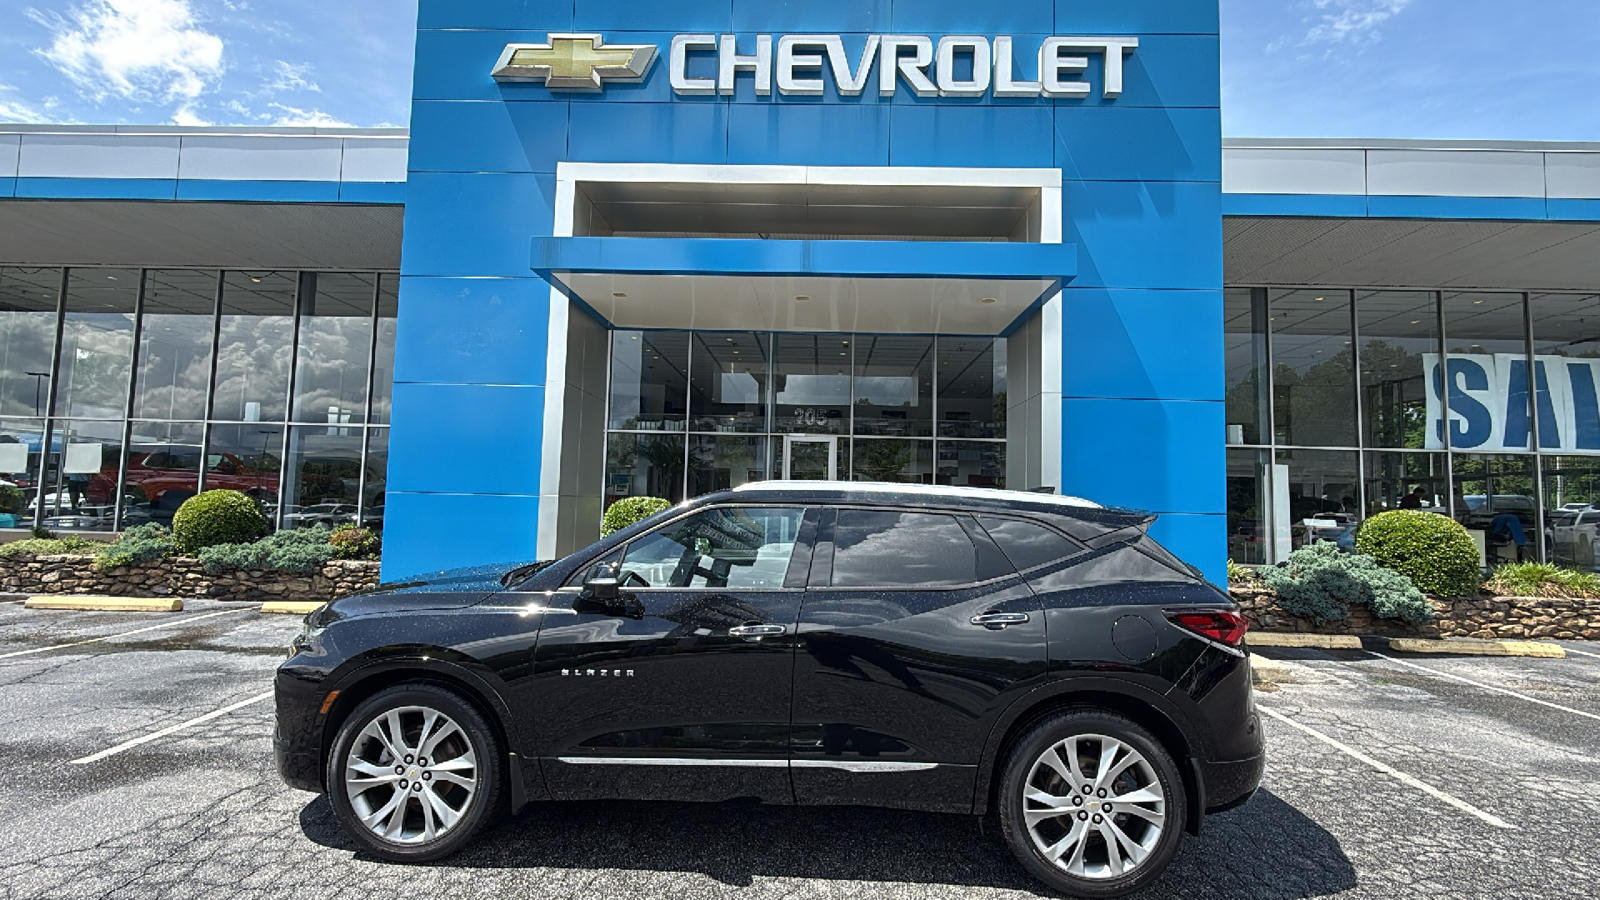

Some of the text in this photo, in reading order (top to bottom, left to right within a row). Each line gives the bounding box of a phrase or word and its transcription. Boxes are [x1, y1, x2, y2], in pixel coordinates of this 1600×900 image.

[669, 33, 1139, 99] CHEVROLET
[794, 407, 828, 426] 205
[561, 668, 635, 677] BLAZER
